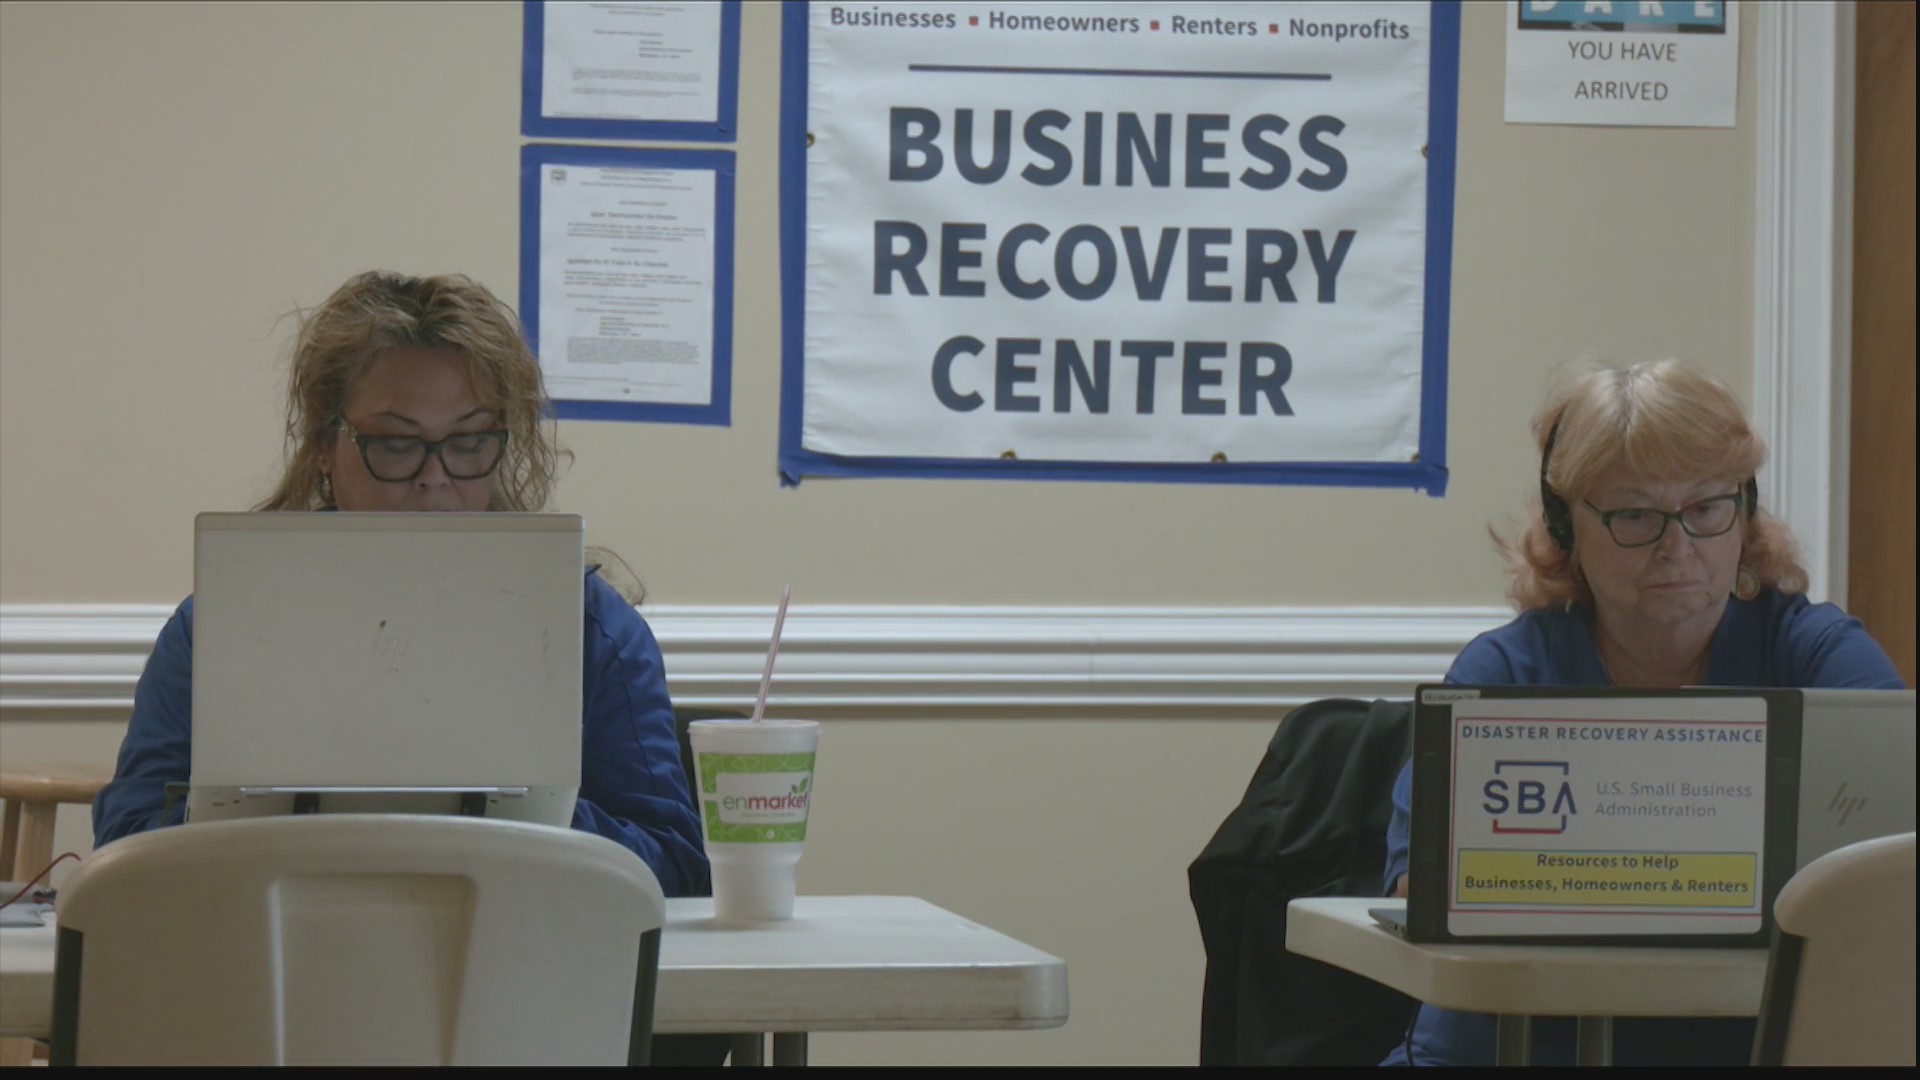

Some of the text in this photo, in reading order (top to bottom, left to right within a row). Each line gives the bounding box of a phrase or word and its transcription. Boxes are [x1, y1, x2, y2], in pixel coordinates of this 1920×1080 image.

[830, 7, 1410, 42] Businesses Homeowners Renters Nonprofits
[1568, 41, 1677, 62] YOU HAVE
[1574, 81, 1669, 101] ARRIVED
[888, 106, 1348, 192] BUSINESS
[873, 220, 1358, 304] RECOVERY
[931, 335, 1295, 416] CENTER
[1461, 725, 1764, 743] DISASTER RECOVERY ASSISTANCE
[1482, 778, 1577, 816] SBA
[1595, 781, 1752, 798] U.S. Small Business
[723, 791, 808, 810] enmarket
[1594, 802, 1717, 818] Administration
[1536, 853, 1679, 871] Resources to Help
[1464, 876, 1749, 893] Businesses, Homeowners & Renters
